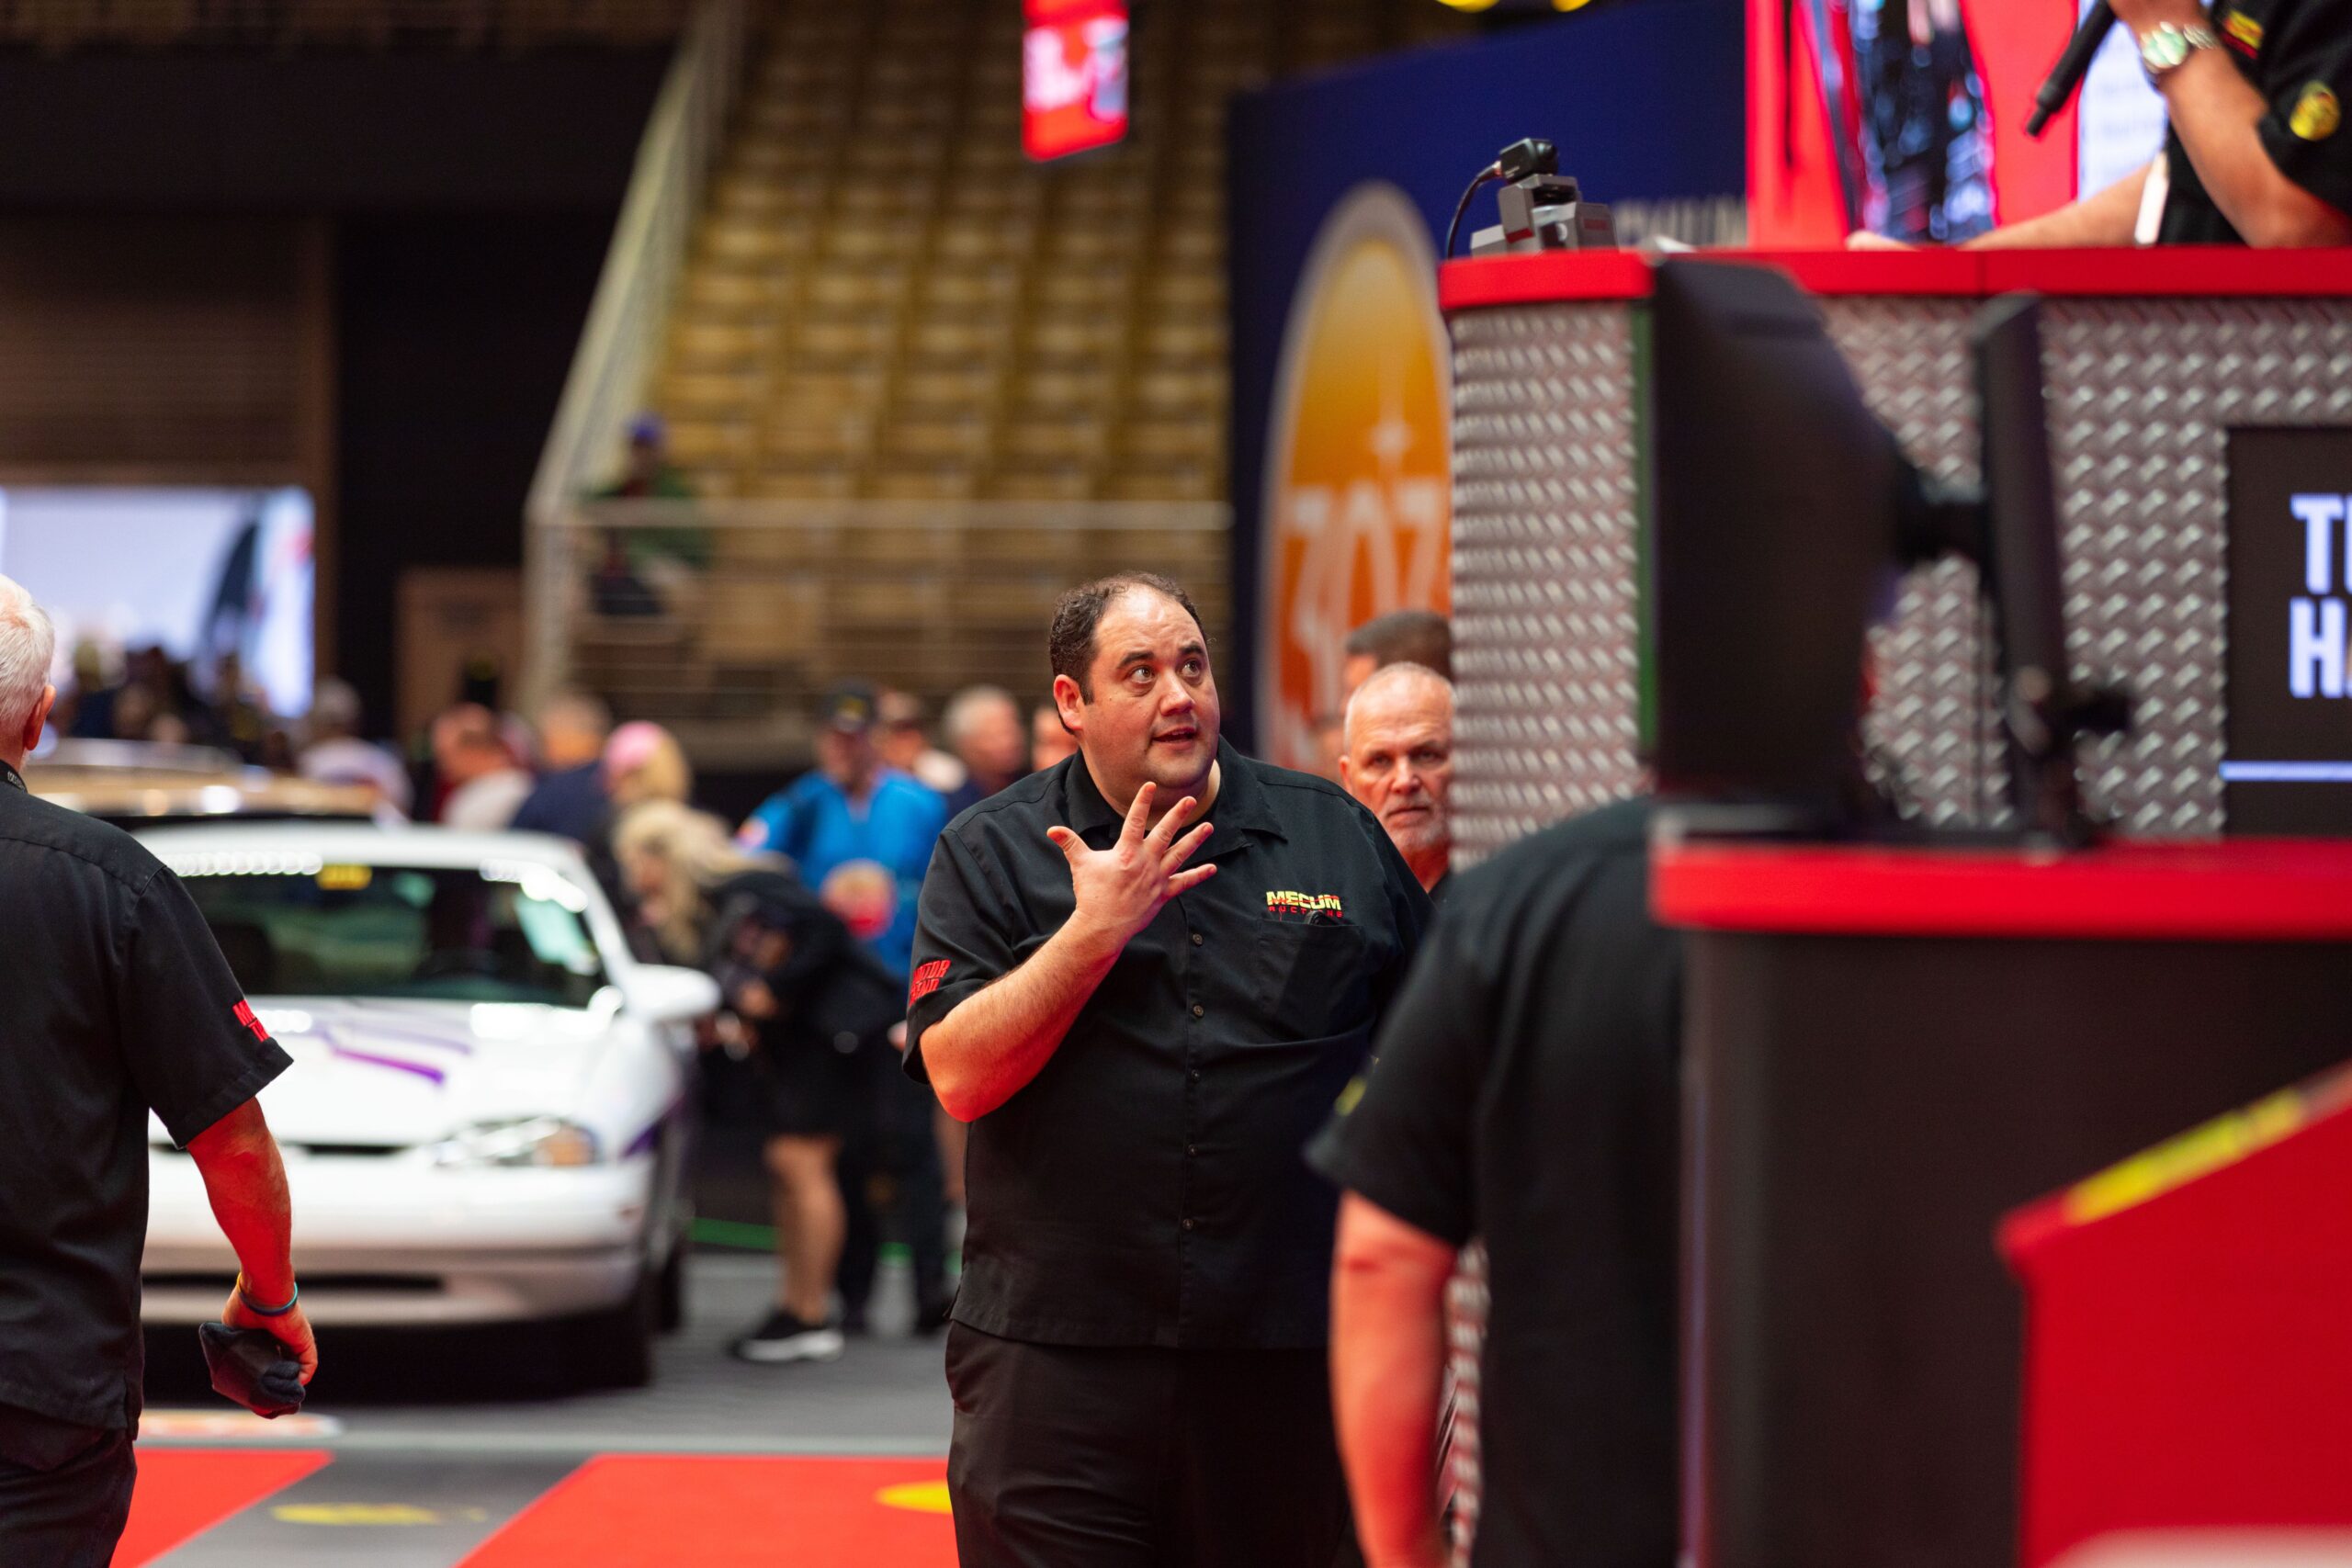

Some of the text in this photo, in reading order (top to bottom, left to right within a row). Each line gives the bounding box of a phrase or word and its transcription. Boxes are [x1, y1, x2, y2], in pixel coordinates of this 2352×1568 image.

[2290, 493, 2352, 595] T
[2289, 596, 2352, 699] H
[1266, 890, 1341, 909] MECUM
[1269, 906, 1343, 918] AUCTNS
